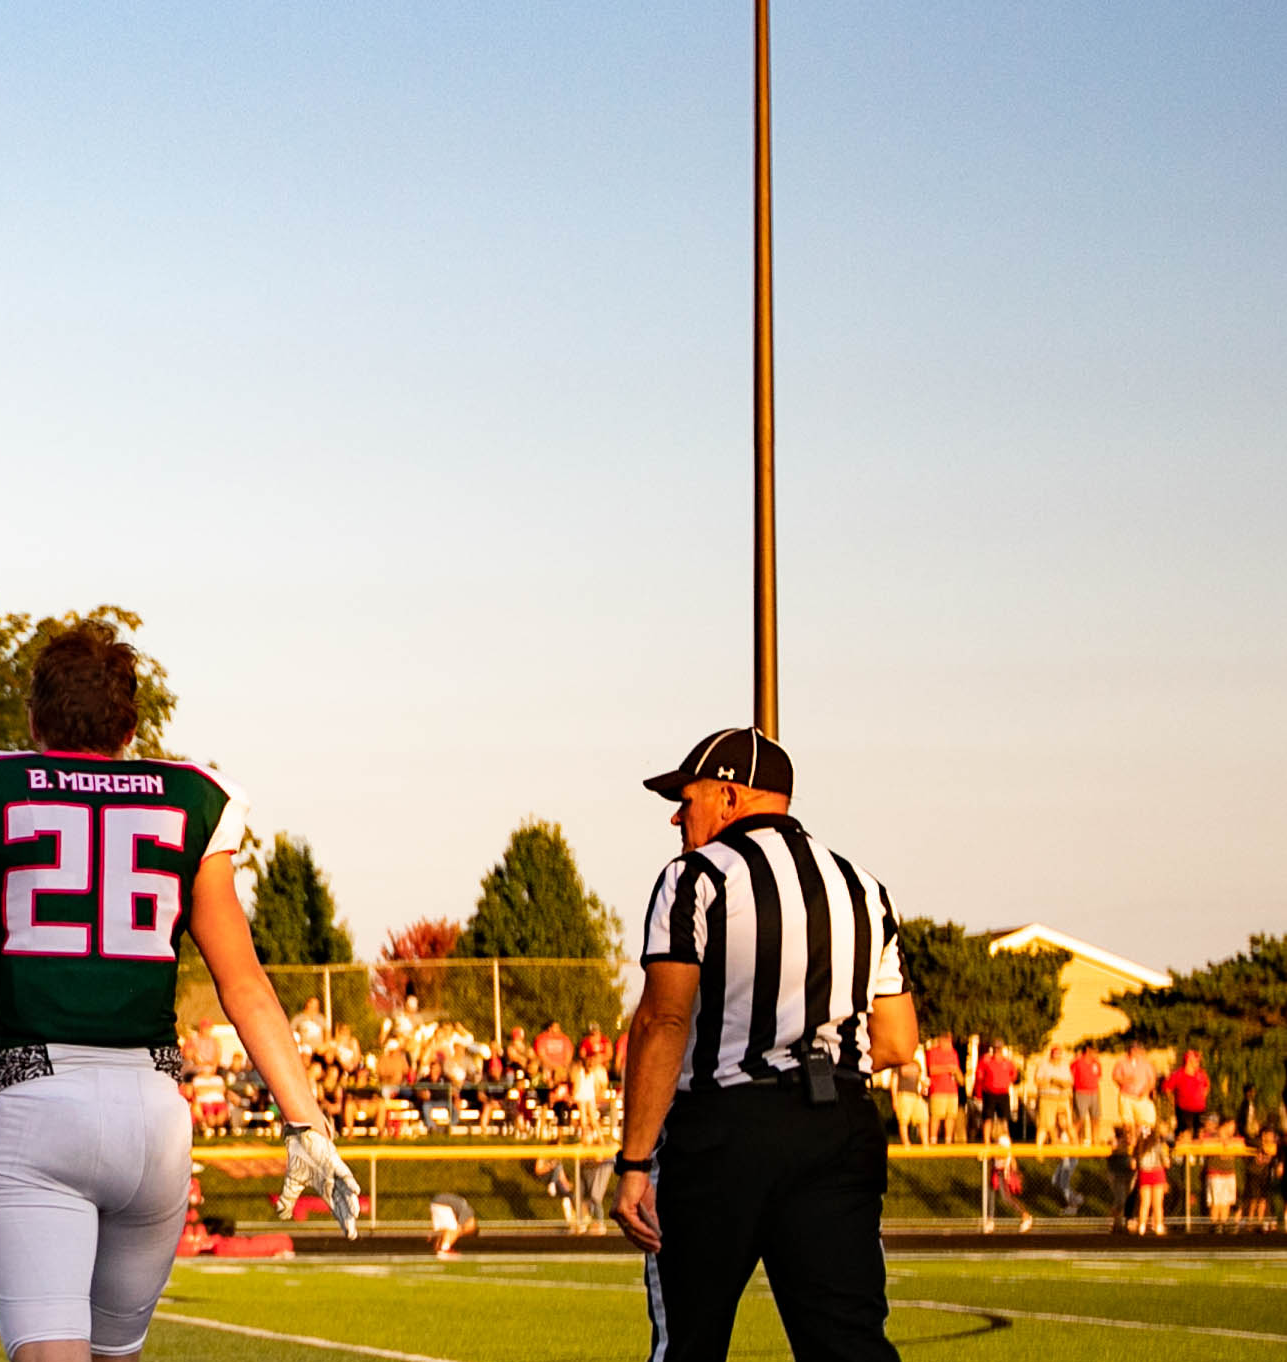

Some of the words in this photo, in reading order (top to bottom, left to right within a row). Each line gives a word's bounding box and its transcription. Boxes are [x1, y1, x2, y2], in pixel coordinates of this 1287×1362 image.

[26, 768, 54, 790] B.
[56, 769, 165, 795] MORGAN
[2, 801, 187, 962] 26
